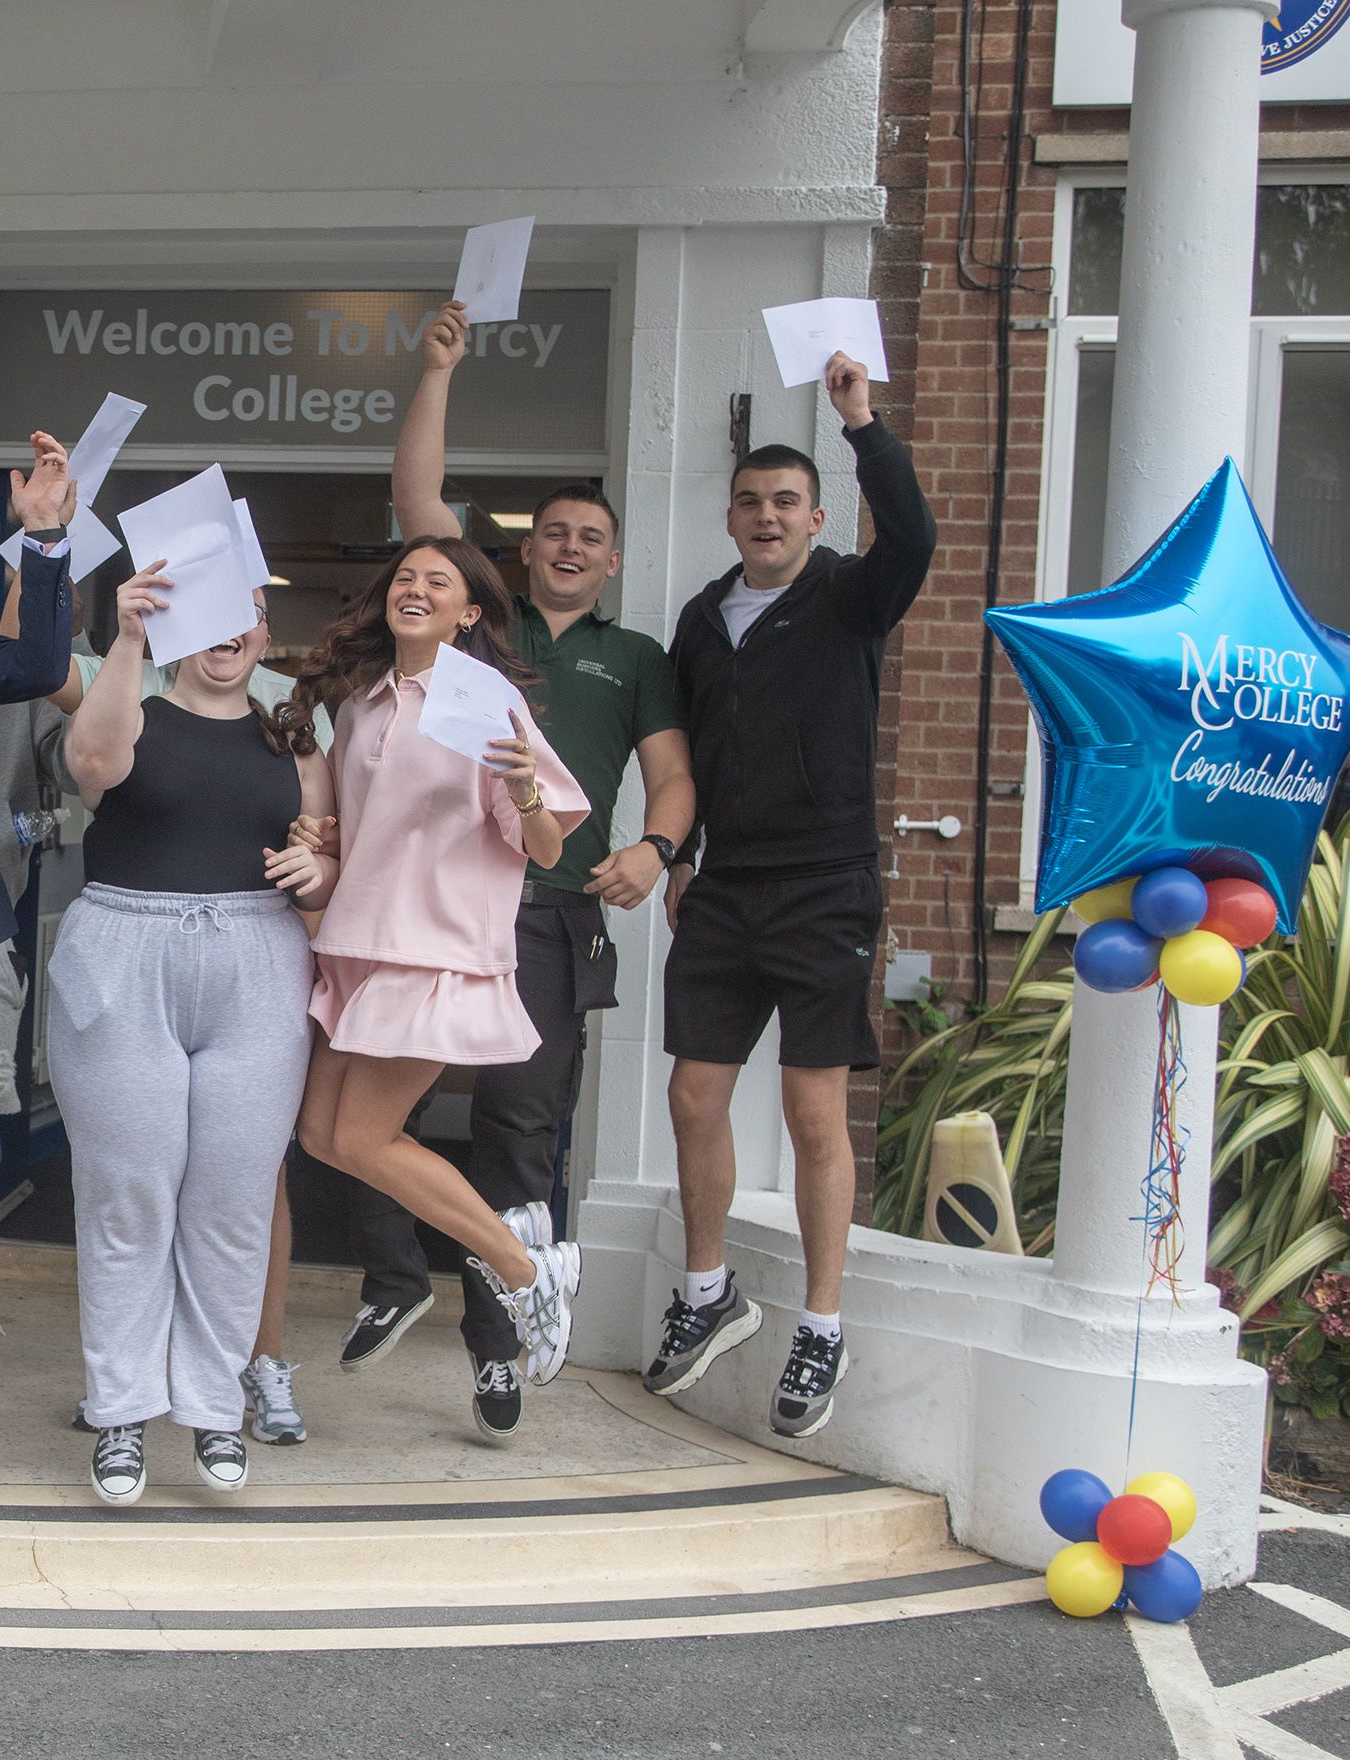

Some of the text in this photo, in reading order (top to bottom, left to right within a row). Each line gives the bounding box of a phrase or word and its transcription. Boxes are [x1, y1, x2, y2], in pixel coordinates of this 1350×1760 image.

[1283, 0, 1338, 49] JUSTICE
[42, 309, 294, 356] Welcome
[307, 310, 369, 357] To
[192, 374, 396, 433] College
[1177, 632, 1318, 694] MERCY
[1191, 679, 1343, 732] COLLEGE
[1171, 730, 1331, 806] Congratulations
